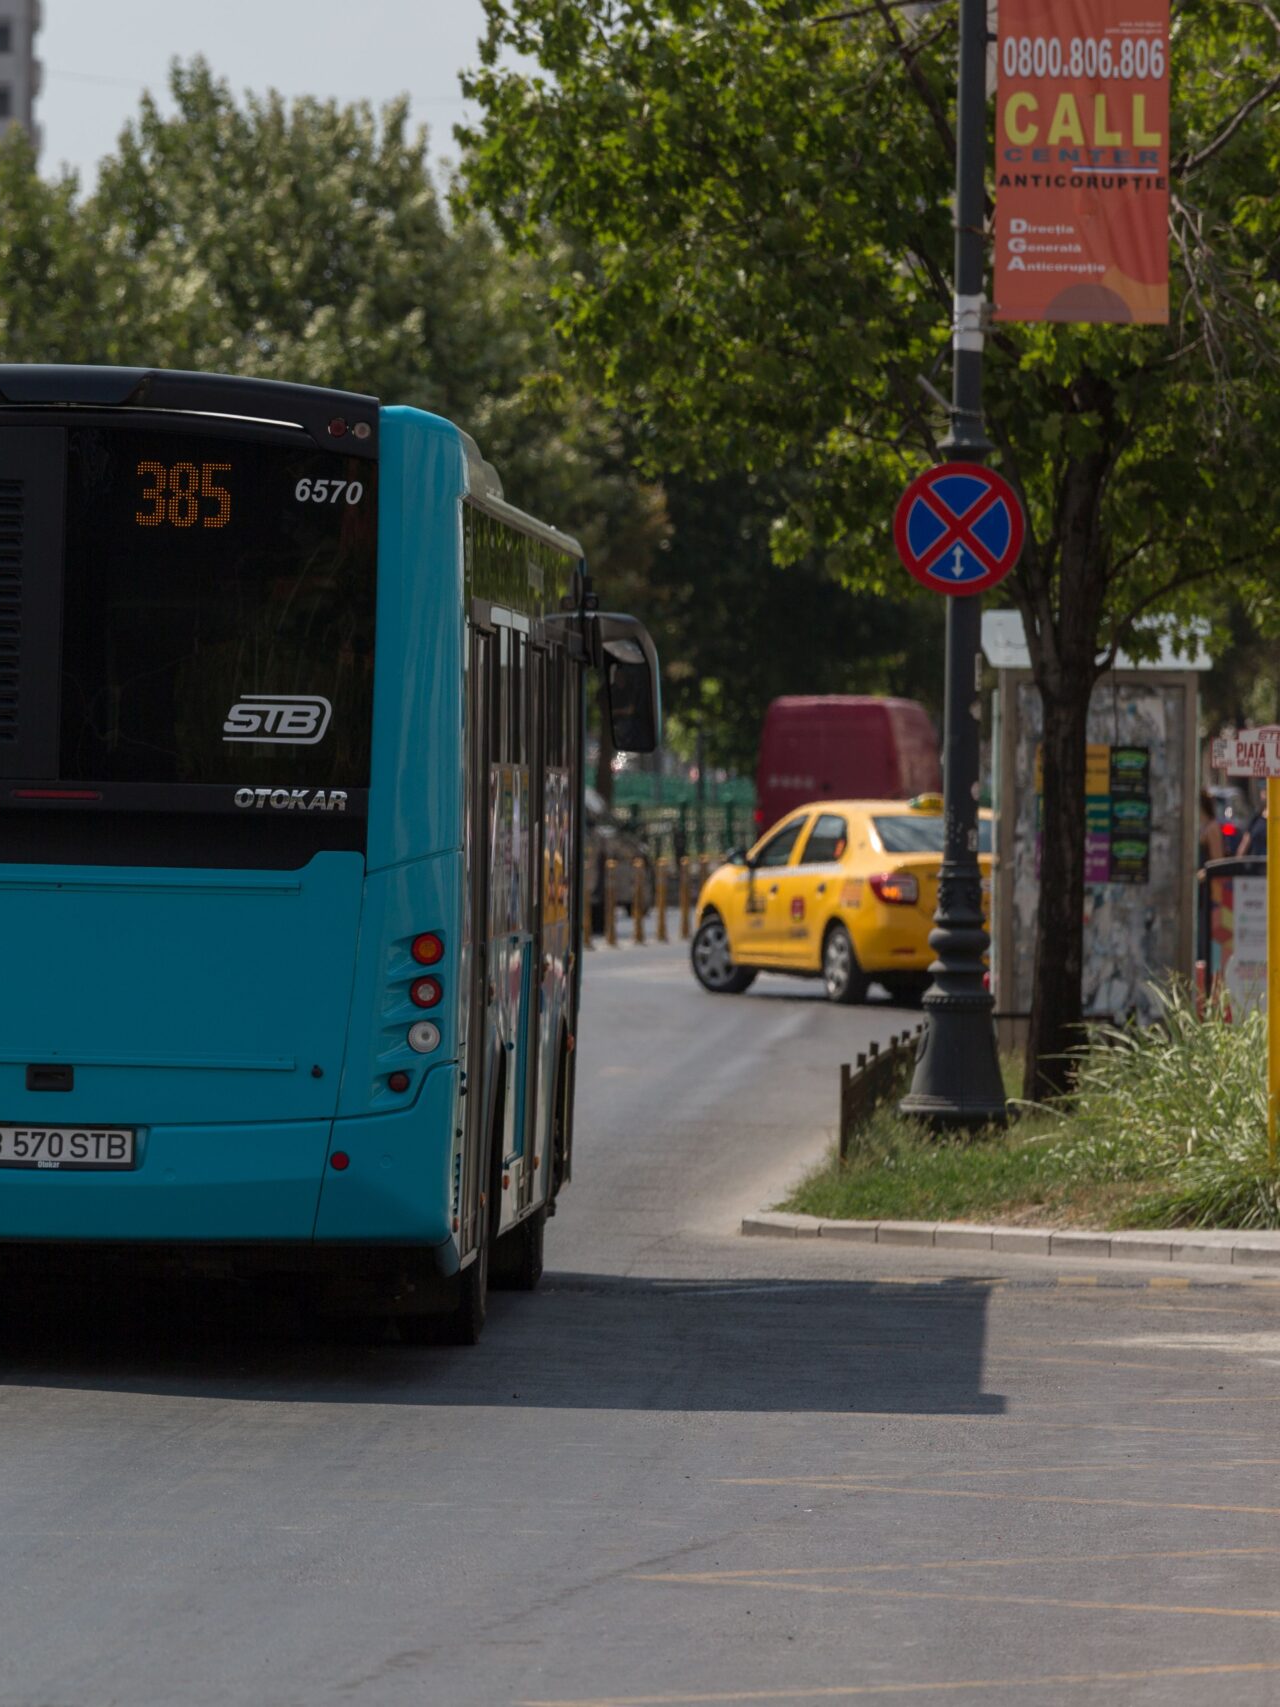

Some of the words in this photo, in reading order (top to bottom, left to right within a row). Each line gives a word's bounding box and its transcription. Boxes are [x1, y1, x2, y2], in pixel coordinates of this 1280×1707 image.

[1003, 36, 1165, 79] 0800.806.806
[1004, 91, 1162, 147] CALL
[1004, 149, 1159, 164] CENTER
[136, 461, 232, 528] 385
[295, 478, 363, 505] 6570
[223, 703, 321, 734] STB
[234, 788, 348, 811] OTOKAR
[13, 1131, 63, 1158] 570
[70, 1133, 127, 1159] STB
